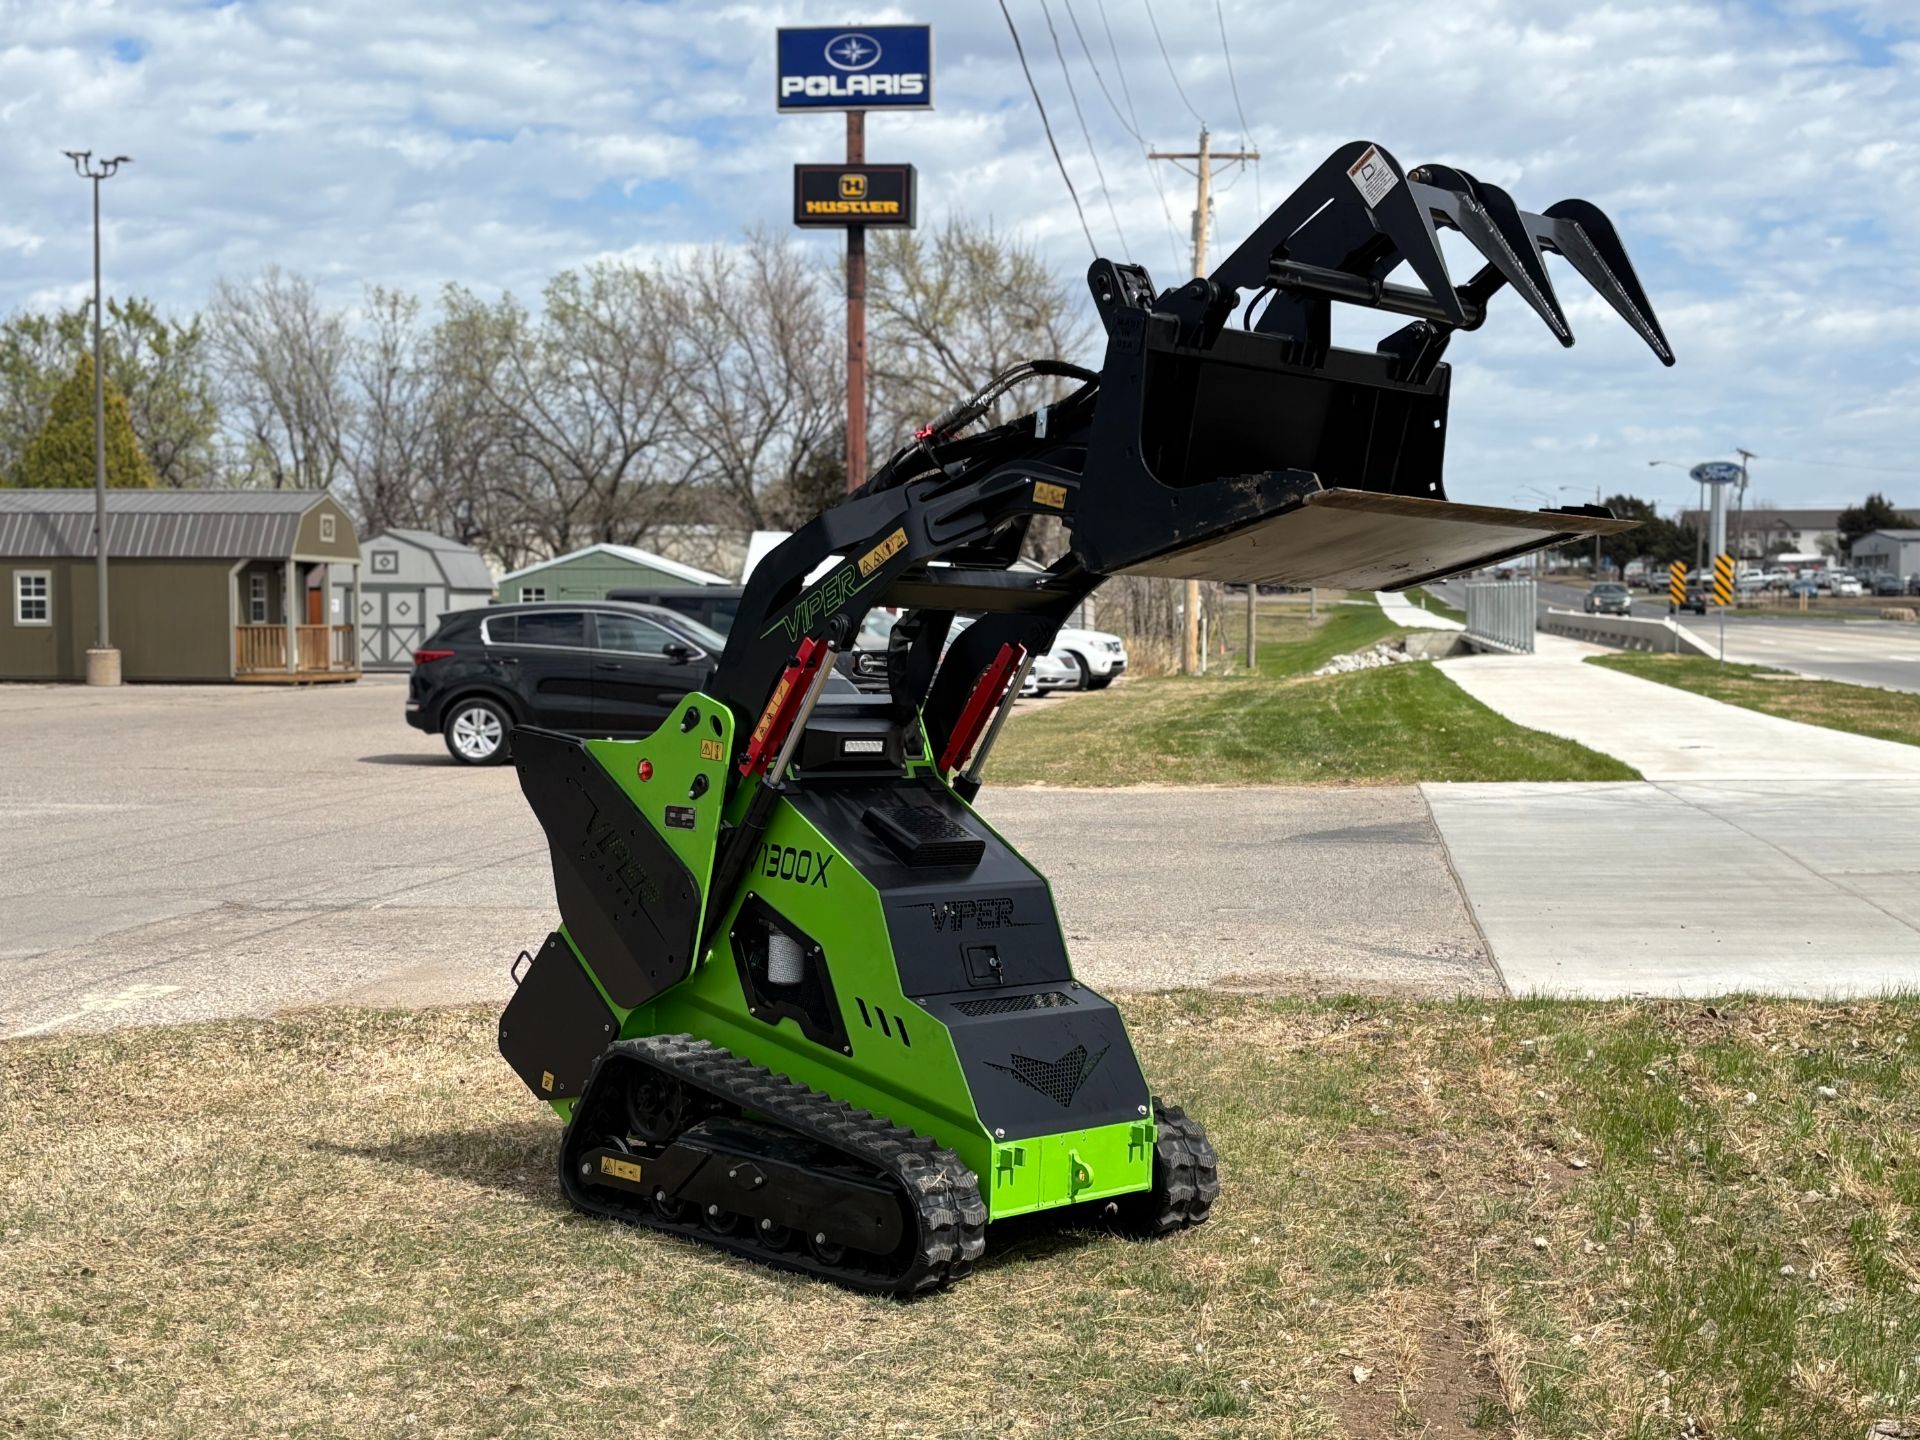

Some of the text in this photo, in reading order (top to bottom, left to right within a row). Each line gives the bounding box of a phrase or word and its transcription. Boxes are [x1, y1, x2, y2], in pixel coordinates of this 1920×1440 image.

[781, 73, 924, 98] POLARIS
[805, 201, 899, 214] HUSTLER
[777, 564, 859, 643] VIPER
[924, 897, 1018, 933] VIPER
